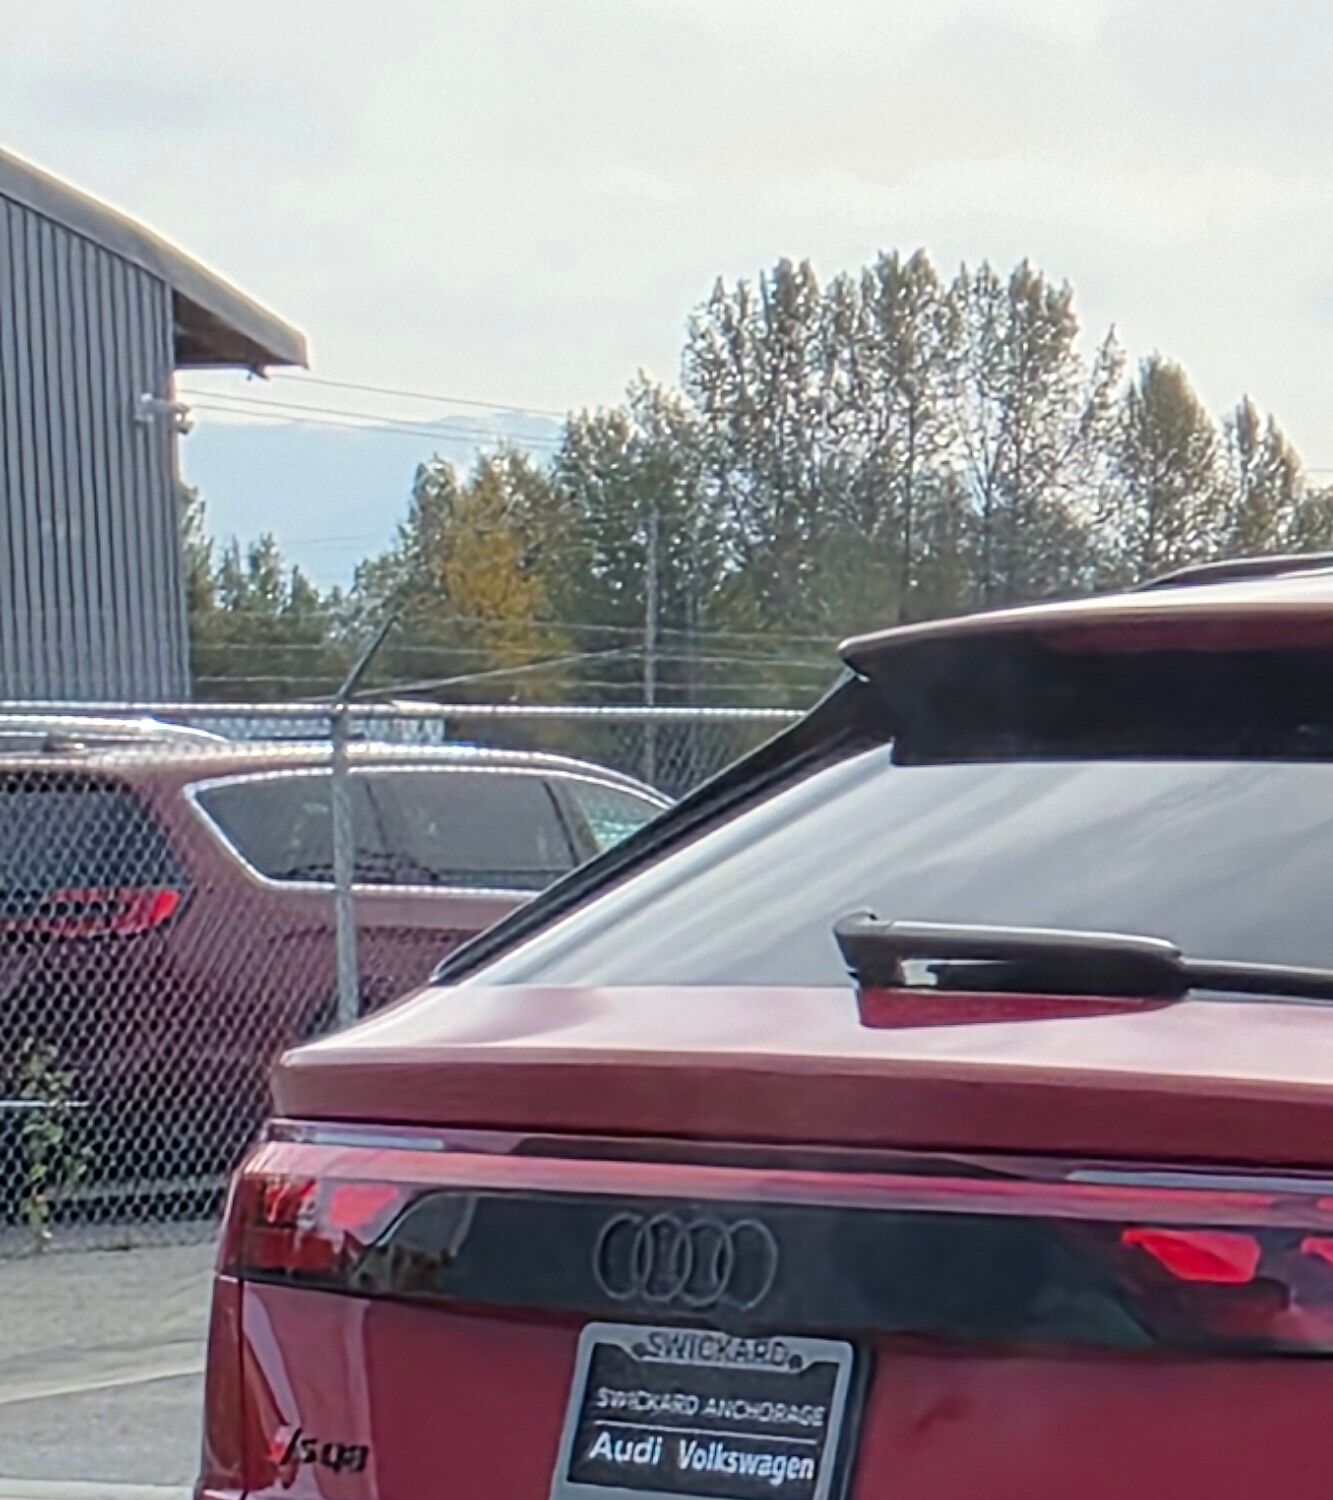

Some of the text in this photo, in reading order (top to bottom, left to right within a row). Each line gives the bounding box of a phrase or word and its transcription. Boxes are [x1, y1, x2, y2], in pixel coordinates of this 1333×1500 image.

[648, 1331, 790, 1368] SWICKARD
[596, 1386, 826, 1427] SWICKARD ANCHORAGE
[588, 1430, 816, 1487] Audi Volkswagen
